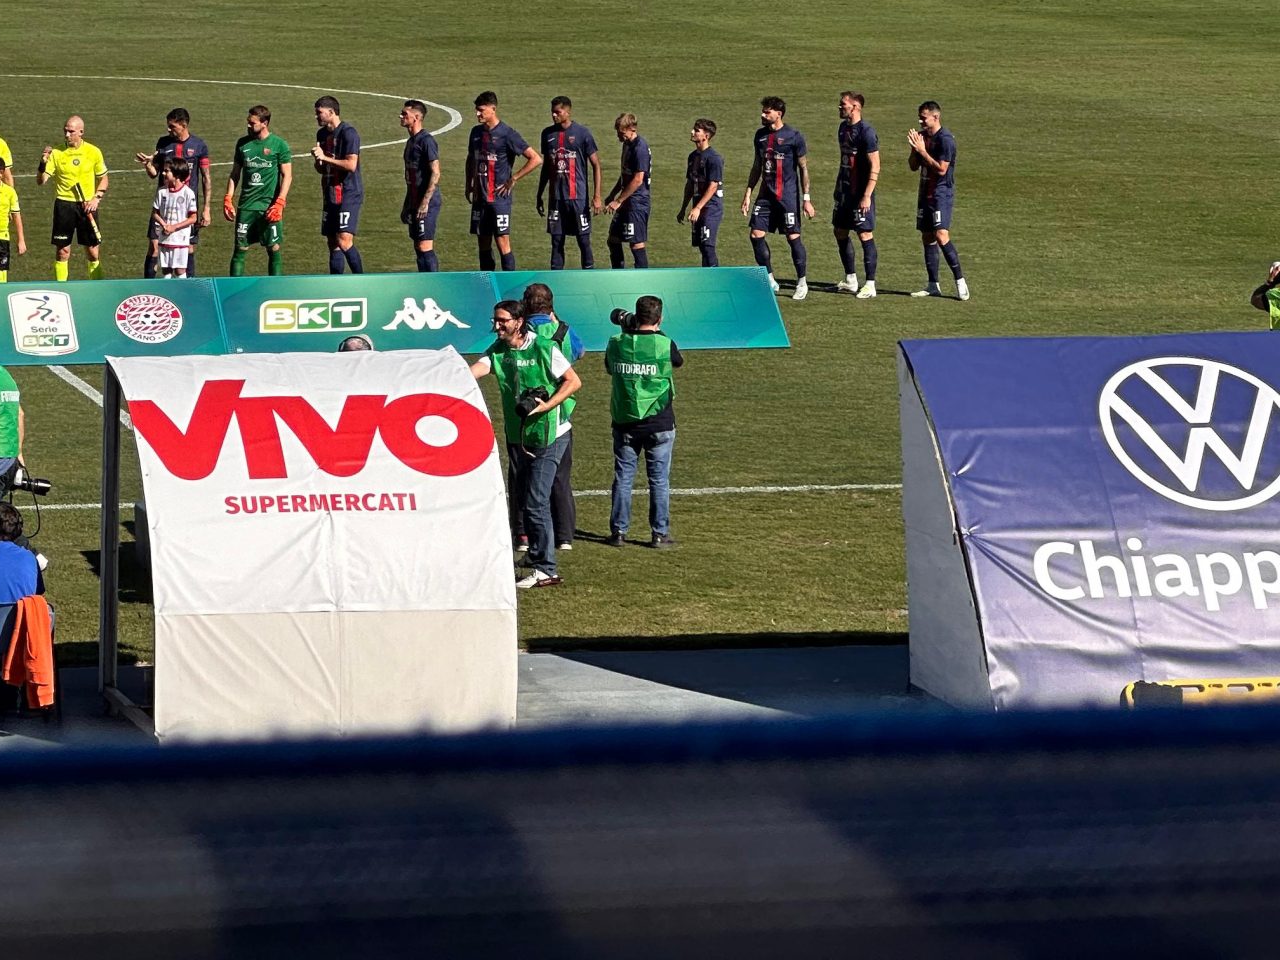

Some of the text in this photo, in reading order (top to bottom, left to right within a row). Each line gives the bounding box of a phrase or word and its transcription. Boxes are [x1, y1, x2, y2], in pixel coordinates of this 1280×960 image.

[339, 211, 351, 225] 17
[496, 214, 509, 228] 23
[271, 225, 278, 238] 1
[265, 304, 363, 329] BKT
[31, 326, 58, 334] Serie
[23, 335, 69, 348] BKT
[129, 379, 495, 480] VIVO
[224, 493, 418, 515] SUPERMERCATI
